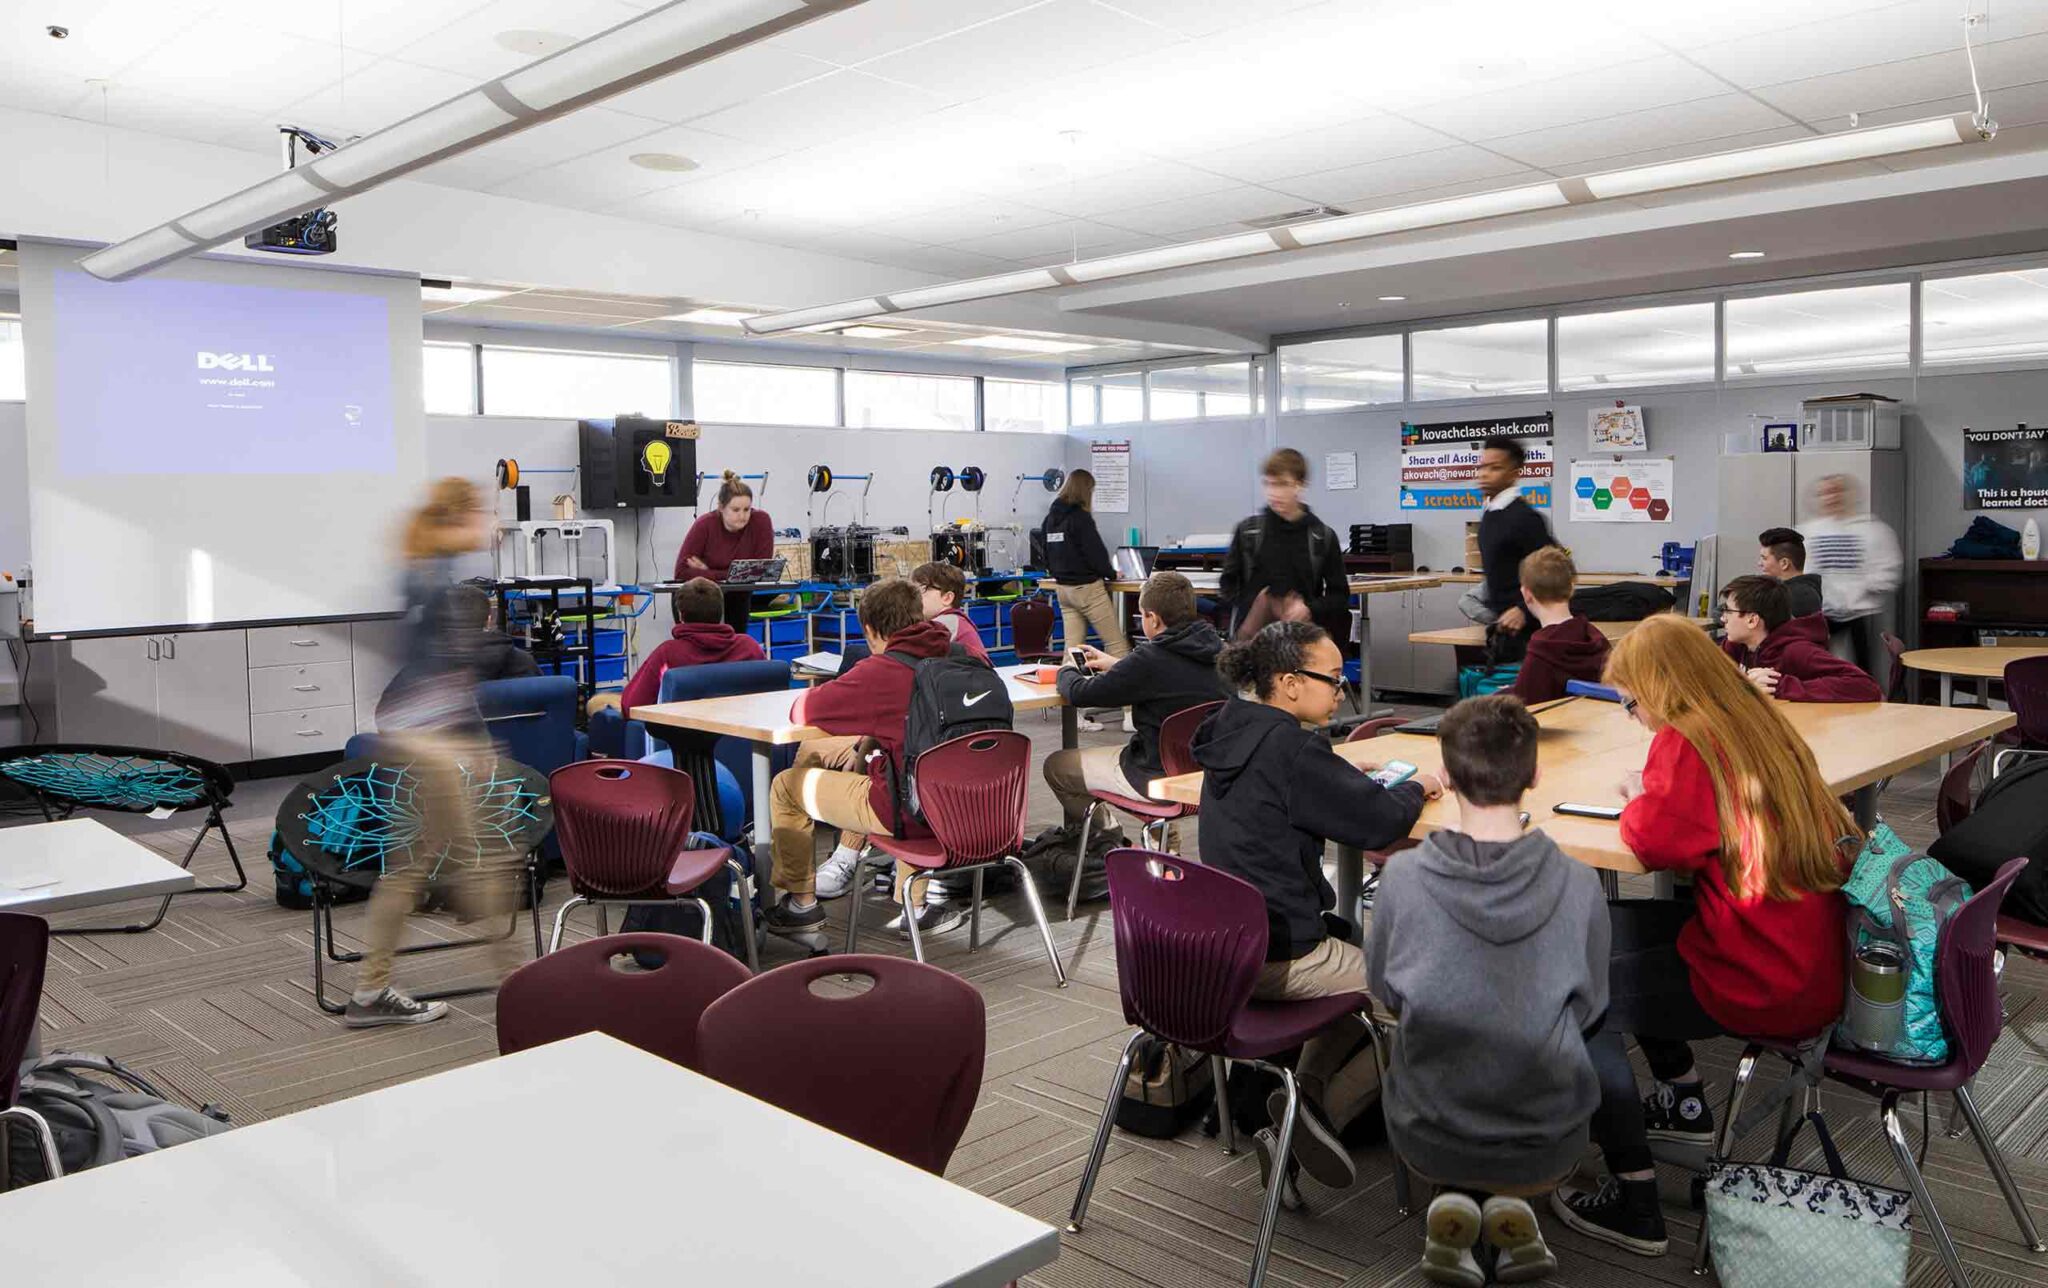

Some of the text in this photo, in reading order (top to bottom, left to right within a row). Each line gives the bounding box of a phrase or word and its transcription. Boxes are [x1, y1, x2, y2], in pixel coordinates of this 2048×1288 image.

[197, 351, 274, 372] DELL
[199, 377, 275, 388] www.dell.com
[1422, 423, 1549, 440] kovachclass.slack.com
[1993, 431, 2023, 441] DON'T
[2026, 430, 2044, 439] SAY
[1408, 455, 1436, 466] Share
[1438, 454, 1449, 464] all
[1977, 488, 1998, 498] This
[2000, 488, 2007, 497] is
[1982, 497, 2048, 508] learned doct
